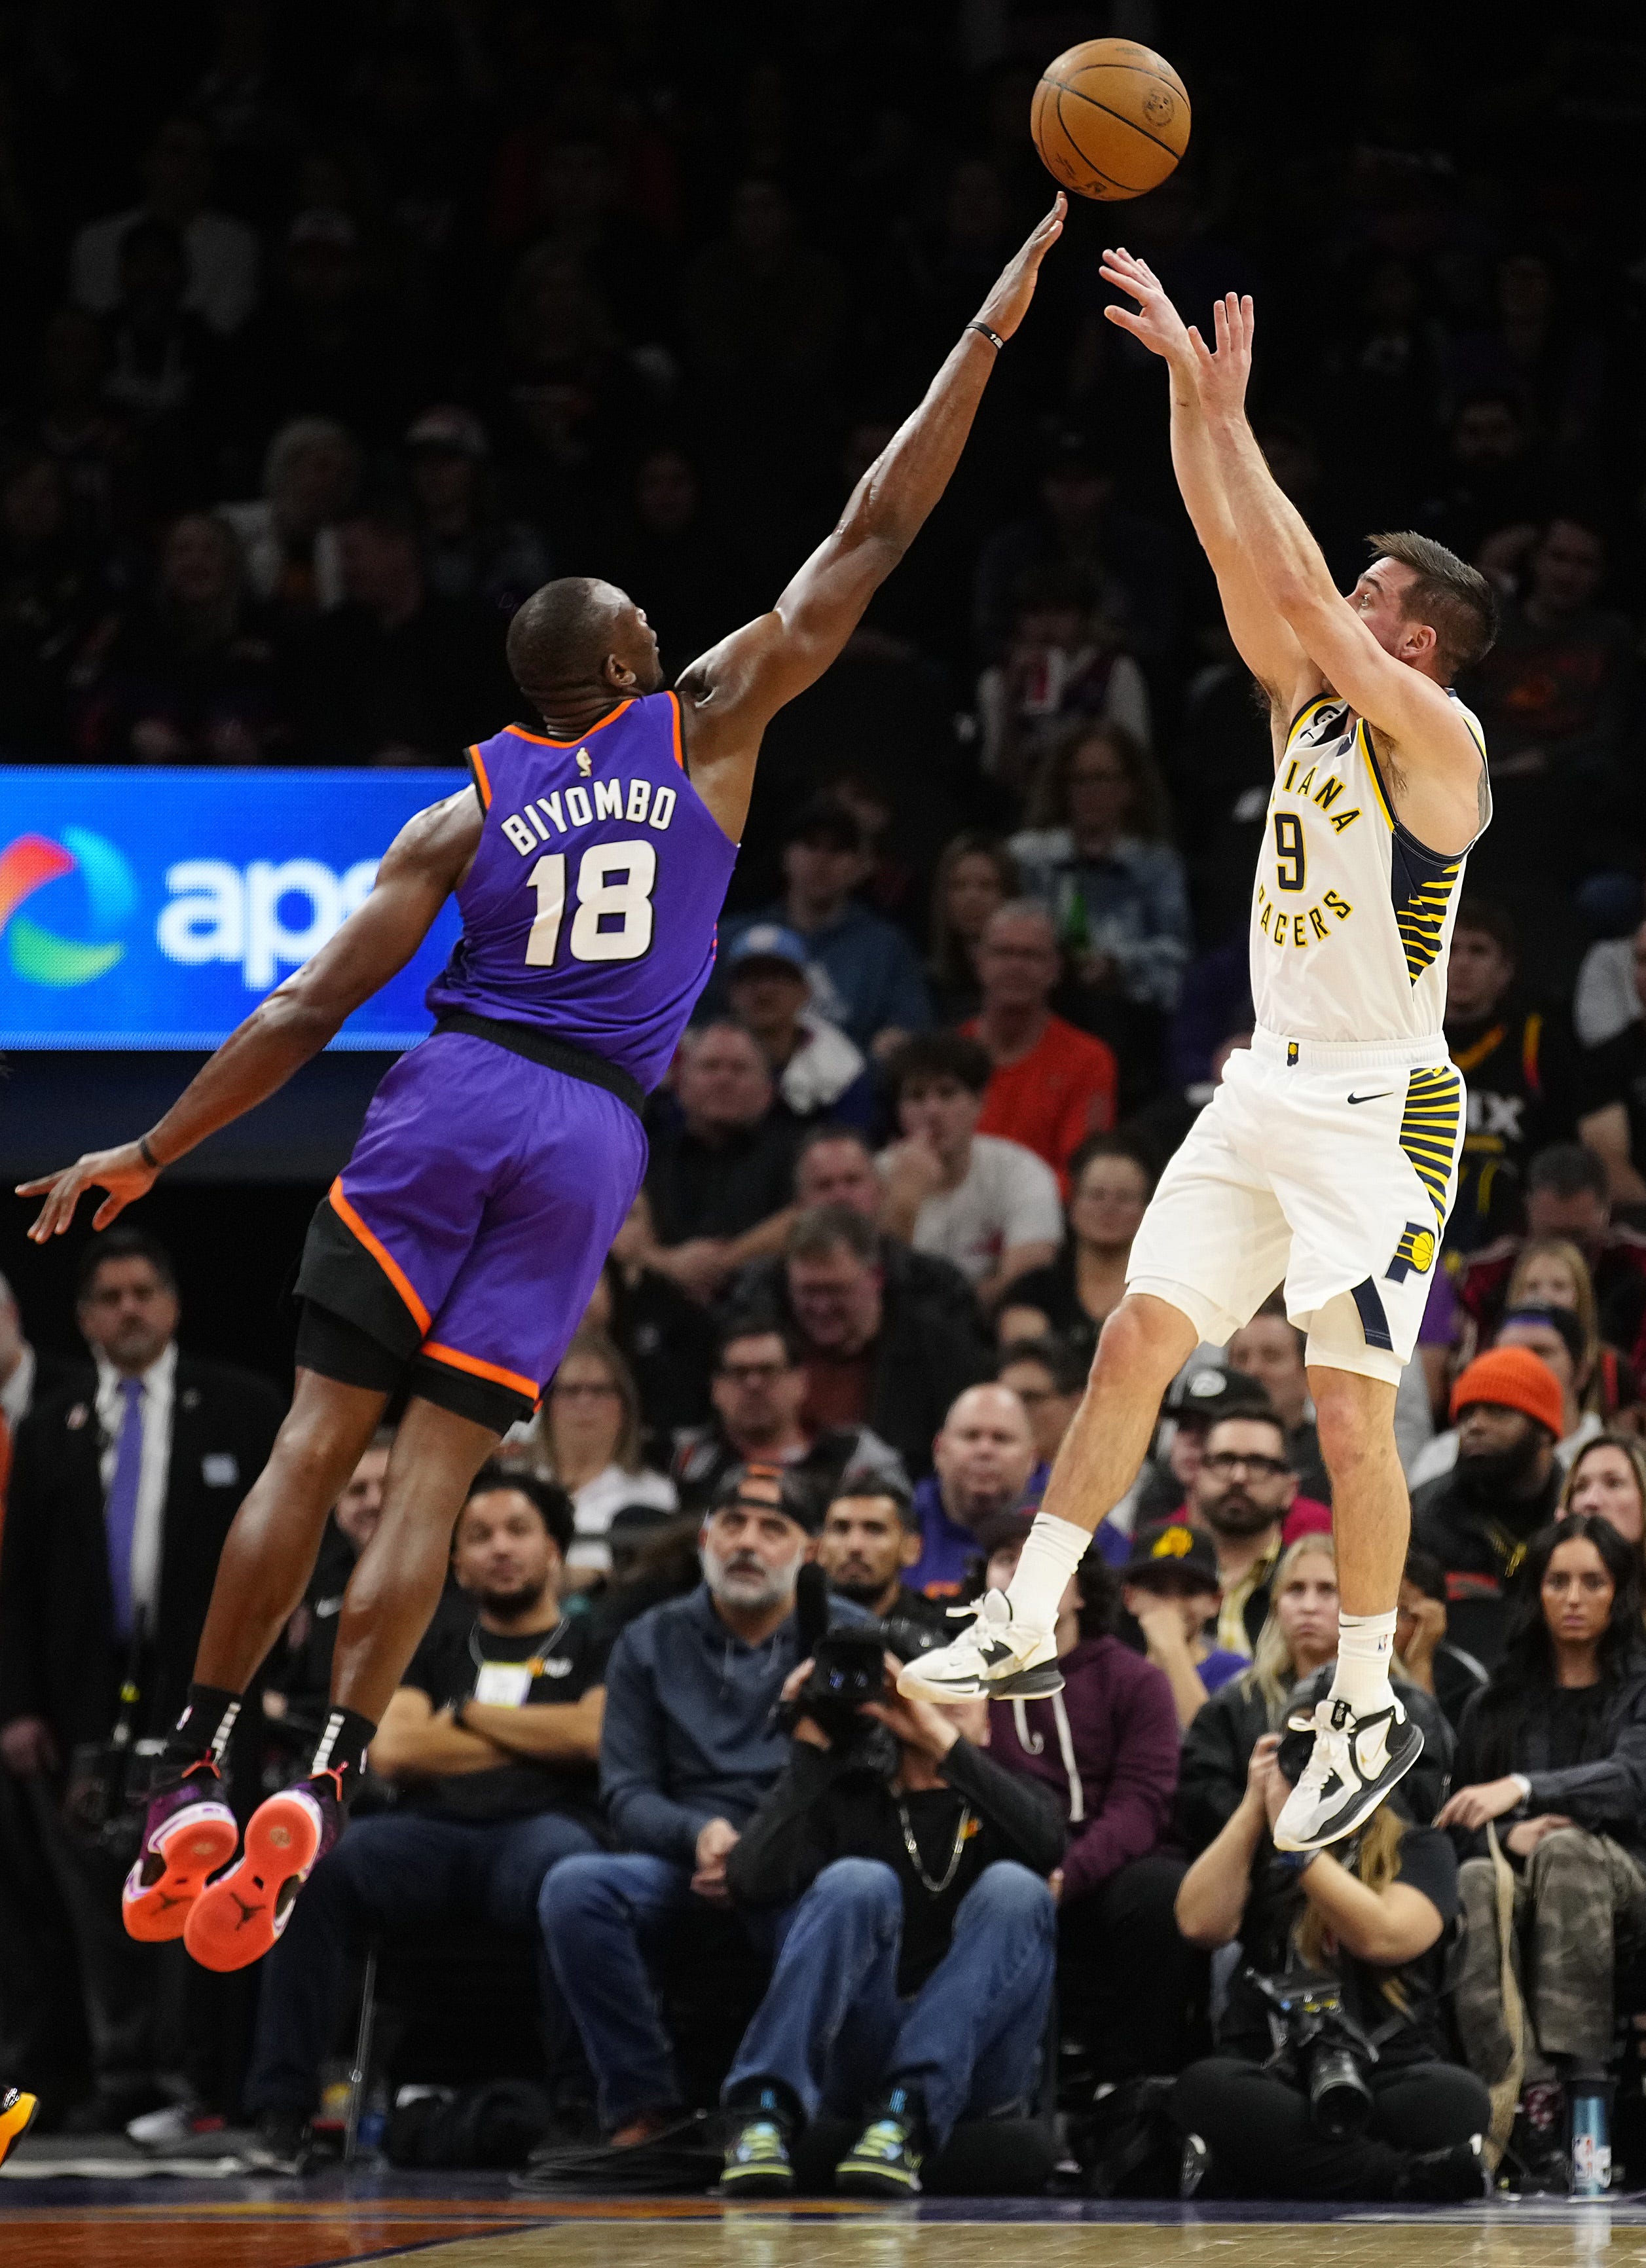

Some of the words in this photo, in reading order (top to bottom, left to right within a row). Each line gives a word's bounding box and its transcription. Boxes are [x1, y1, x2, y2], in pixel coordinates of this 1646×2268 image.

[501, 778, 677, 856] BIYOMBO
[1282, 759, 1363, 835] IANA
[1274, 811, 1307, 892] 9
[524, 839, 657, 967] 18
